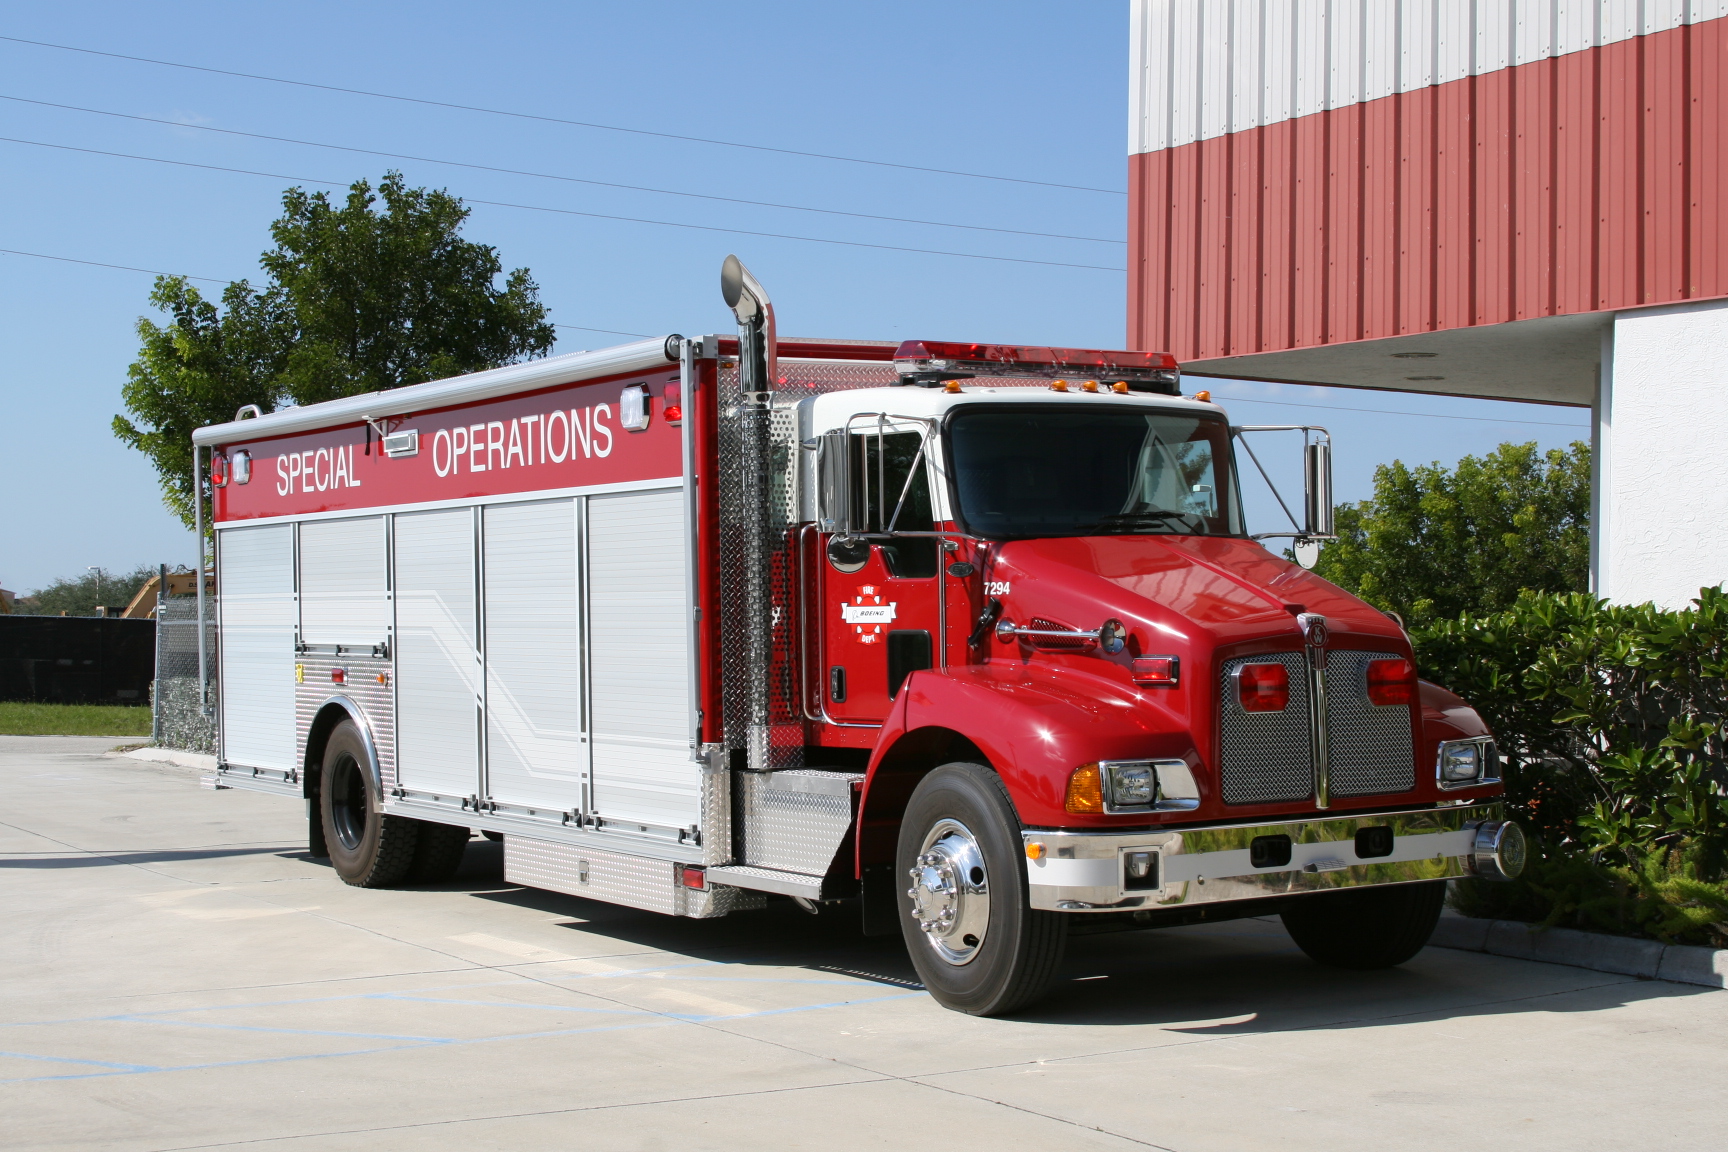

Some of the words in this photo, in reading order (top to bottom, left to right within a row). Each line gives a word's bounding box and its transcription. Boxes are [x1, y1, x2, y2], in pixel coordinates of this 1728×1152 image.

[276, 443, 361, 497] SPECIAL
[432, 403, 613, 478] OPERATIONS
[862, 586, 875, 595] FIRE
[984, 581, 1010, 595] 7294
[1314, 627, 1321, 635] K
[861, 634, 876, 644] DEPT
[1313, 635, 1323, 643] W
